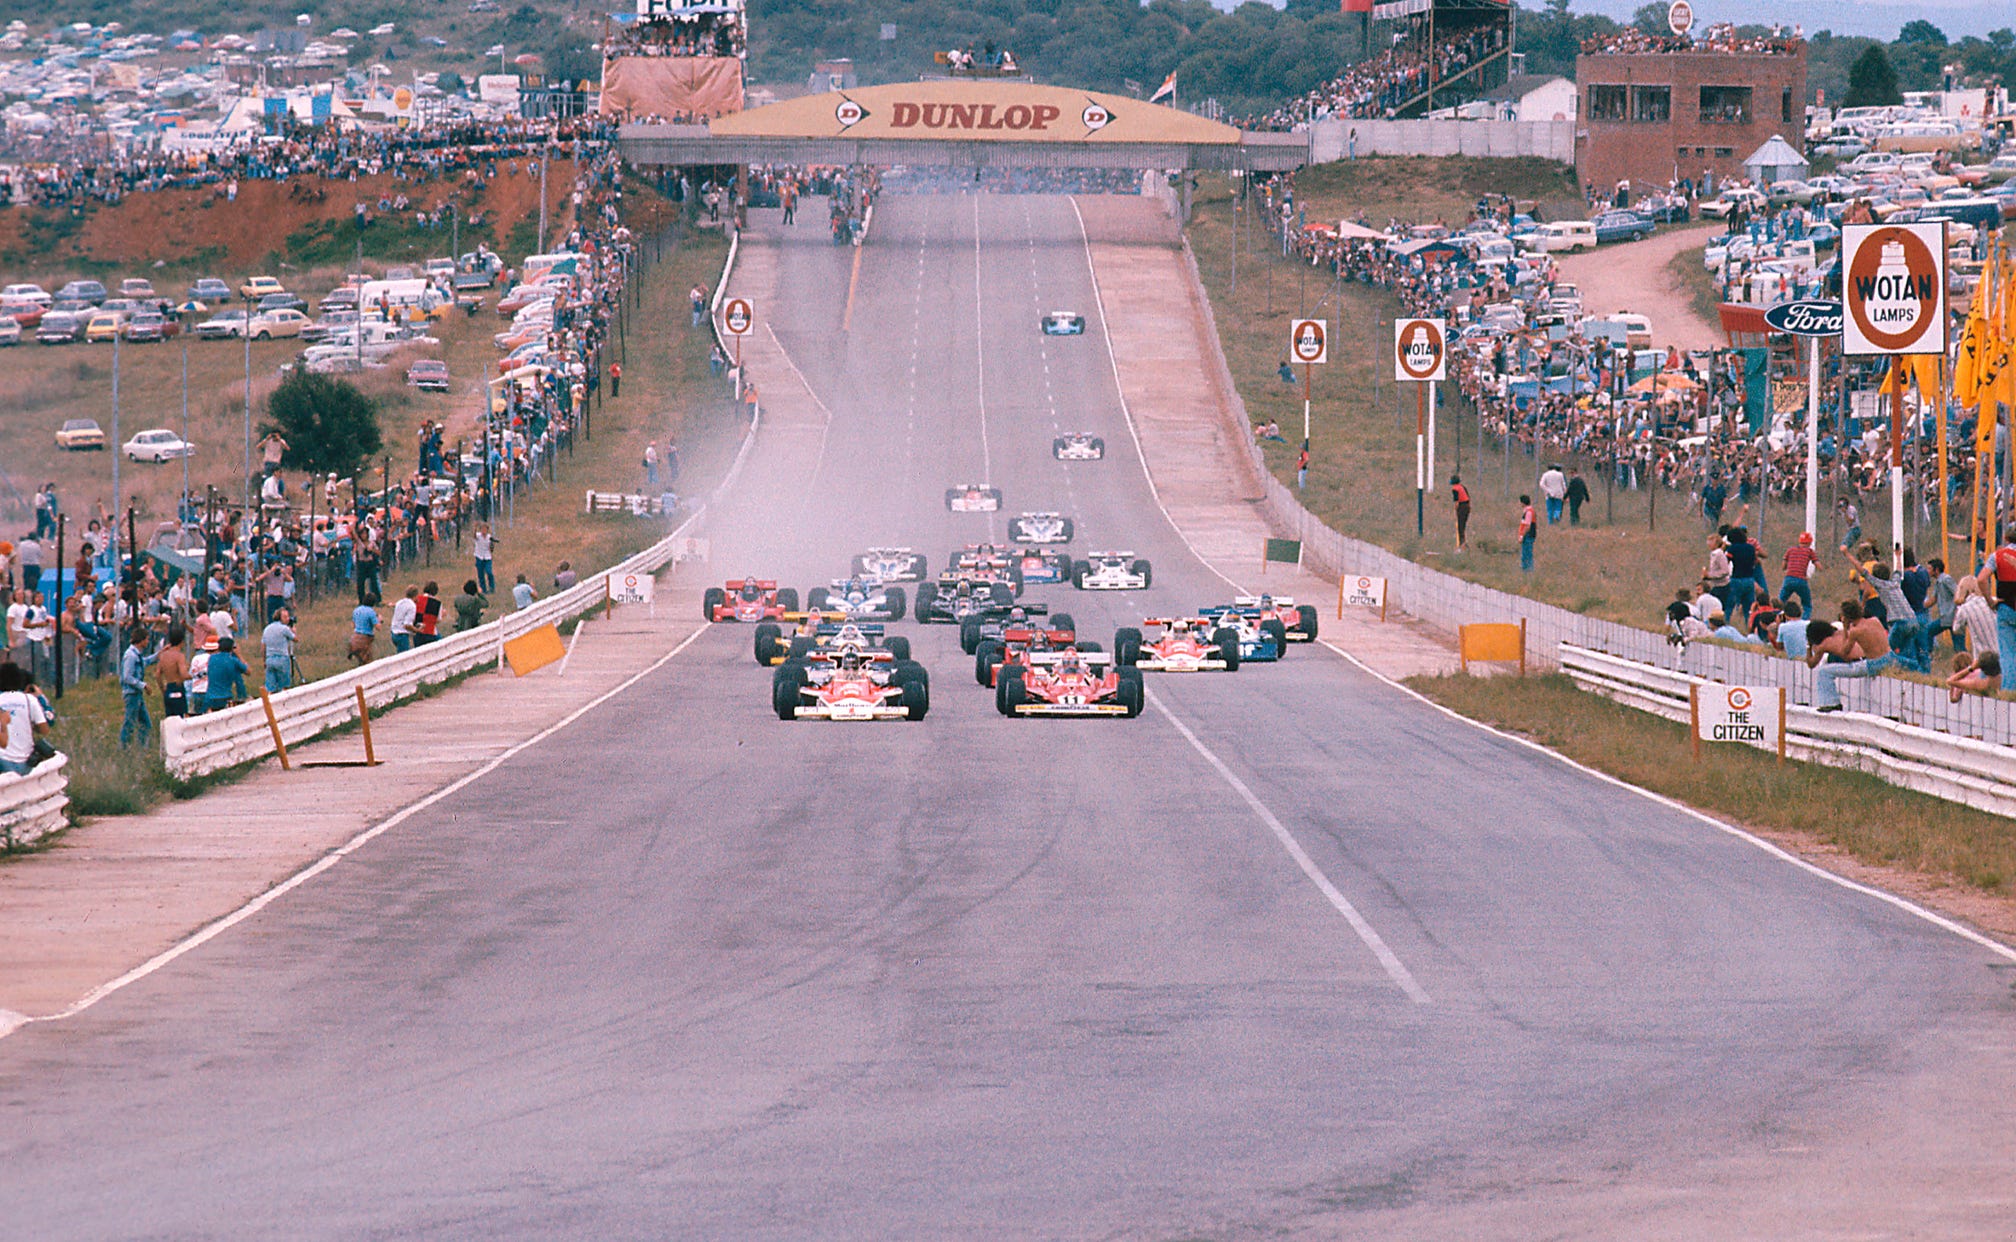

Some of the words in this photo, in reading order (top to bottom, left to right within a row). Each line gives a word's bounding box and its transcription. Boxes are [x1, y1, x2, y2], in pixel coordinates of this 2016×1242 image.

[889, 102, 1060, 130] DUNLOP
[1855, 274, 1932, 302] WOTAN
[1873, 308, 1914, 322] LAMPS
[1296, 336, 1323, 346] WOTAN
[1402, 343, 1441, 356] WOTAN
[1410, 358, 1431, 366] LAMPS
[1063, 696, 1078, 704] 11
[1728, 711, 1750, 724] THE
[1713, 724, 1764, 740] CITIZEN
